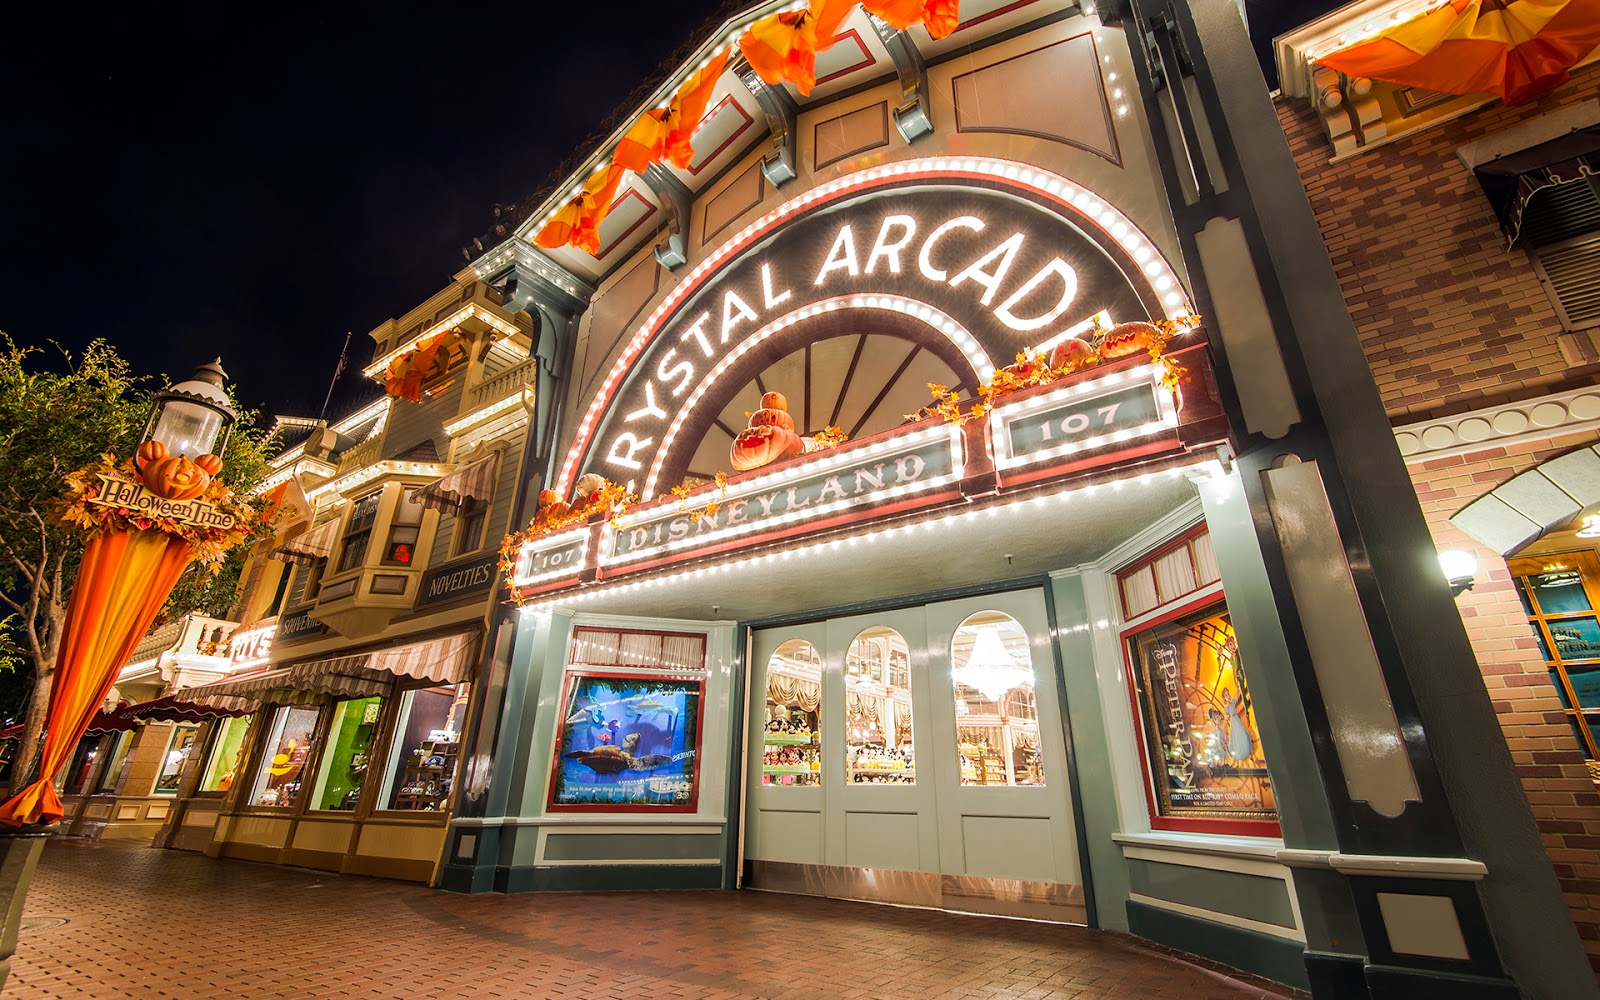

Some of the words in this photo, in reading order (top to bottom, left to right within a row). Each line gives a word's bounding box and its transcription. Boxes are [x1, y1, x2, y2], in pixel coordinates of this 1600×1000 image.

[605, 262, 792, 495] RYSTAL
[1039, 401, 1124, 442] 107
[628, 453, 927, 552] DISNEYLAND
[541, 549, 576, 569] 107
[428, 563, 492, 598] NOVELTIES
[230, 630, 273, 665] TOYS
[1159, 659, 1186, 738] PETER
[1168, 736, 1198, 789] PAN
[649, 779, 691, 791] NEMO
